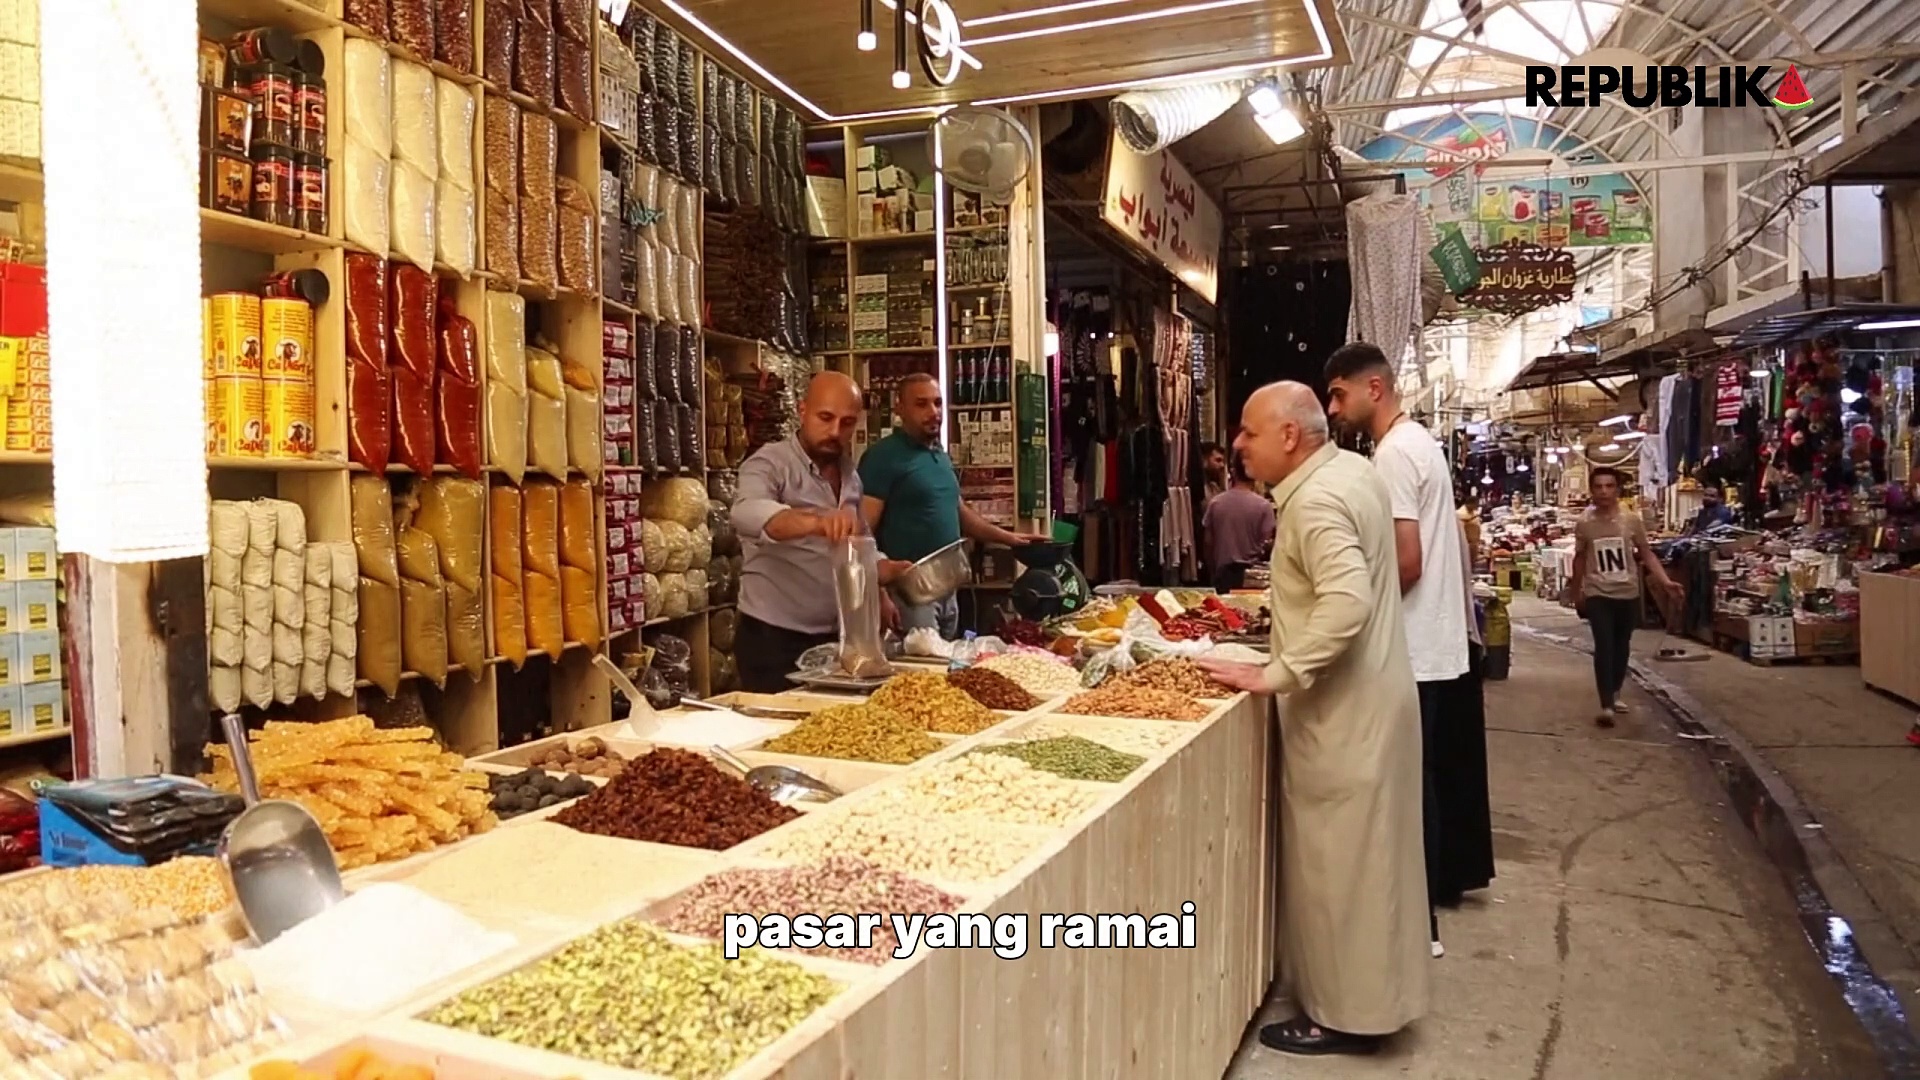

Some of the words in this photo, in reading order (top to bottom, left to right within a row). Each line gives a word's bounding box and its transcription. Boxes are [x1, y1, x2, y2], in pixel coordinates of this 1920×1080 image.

[1477, 266, 1501, 291] الجو
[1536, 266, 1575, 290] عطارية
[1597, 548, 1625, 572] IN
